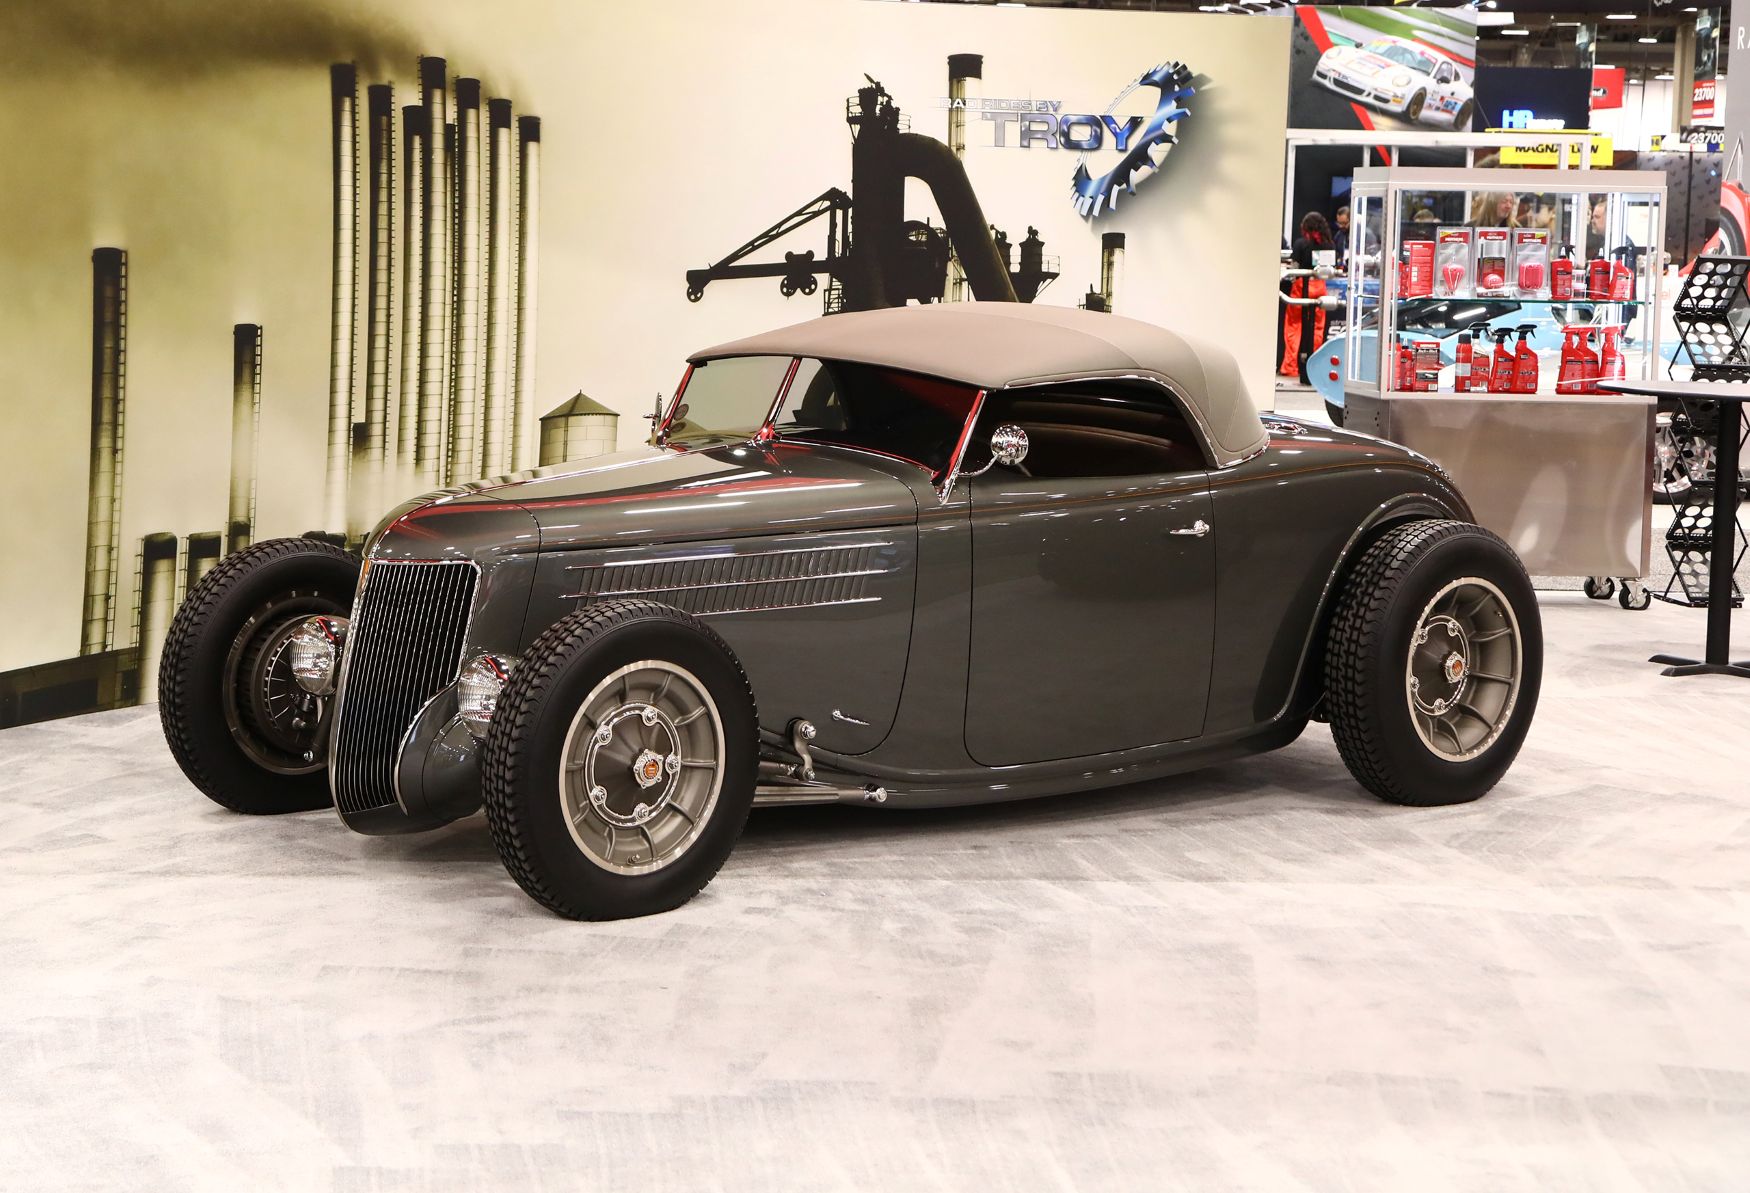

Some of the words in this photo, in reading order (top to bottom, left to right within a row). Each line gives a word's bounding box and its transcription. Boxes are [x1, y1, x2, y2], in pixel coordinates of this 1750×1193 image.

[1737, 26, 1750, 50] R
[1693, 87, 1715, 101] 23700
[940, 97, 976, 109] RAD
[982, 99, 1031, 112] RIDES
[1036, 100, 1061, 113] BY
[981, 112, 1144, 151] TROY
[1689, 132, 1725, 144] 23700
[1515, 143, 1599, 154] MAGNLW
